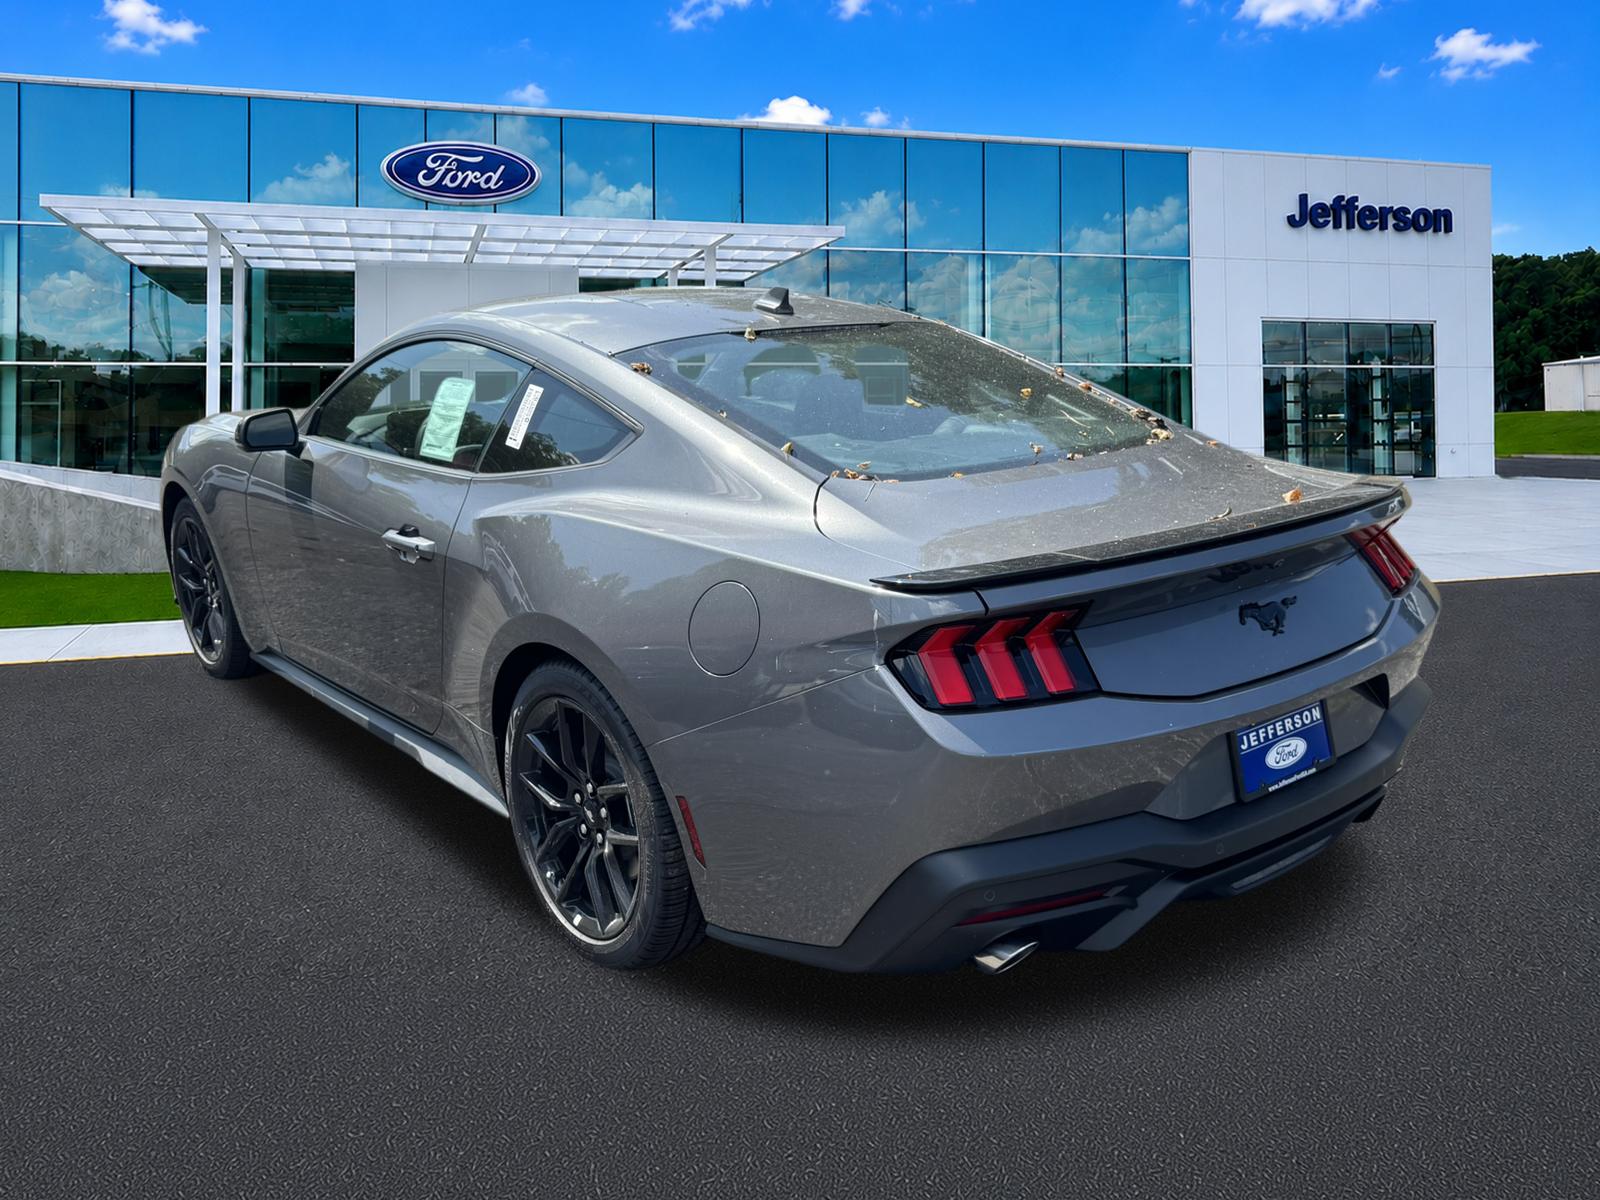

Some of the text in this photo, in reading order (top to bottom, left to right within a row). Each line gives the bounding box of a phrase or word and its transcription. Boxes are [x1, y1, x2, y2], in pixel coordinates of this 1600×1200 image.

[417, 152, 506, 190] Ford
[1286, 193, 1453, 234] Jefferson
[1240, 706, 1321, 750] JEFFERSON
[1274, 743, 1299, 765] Ford
